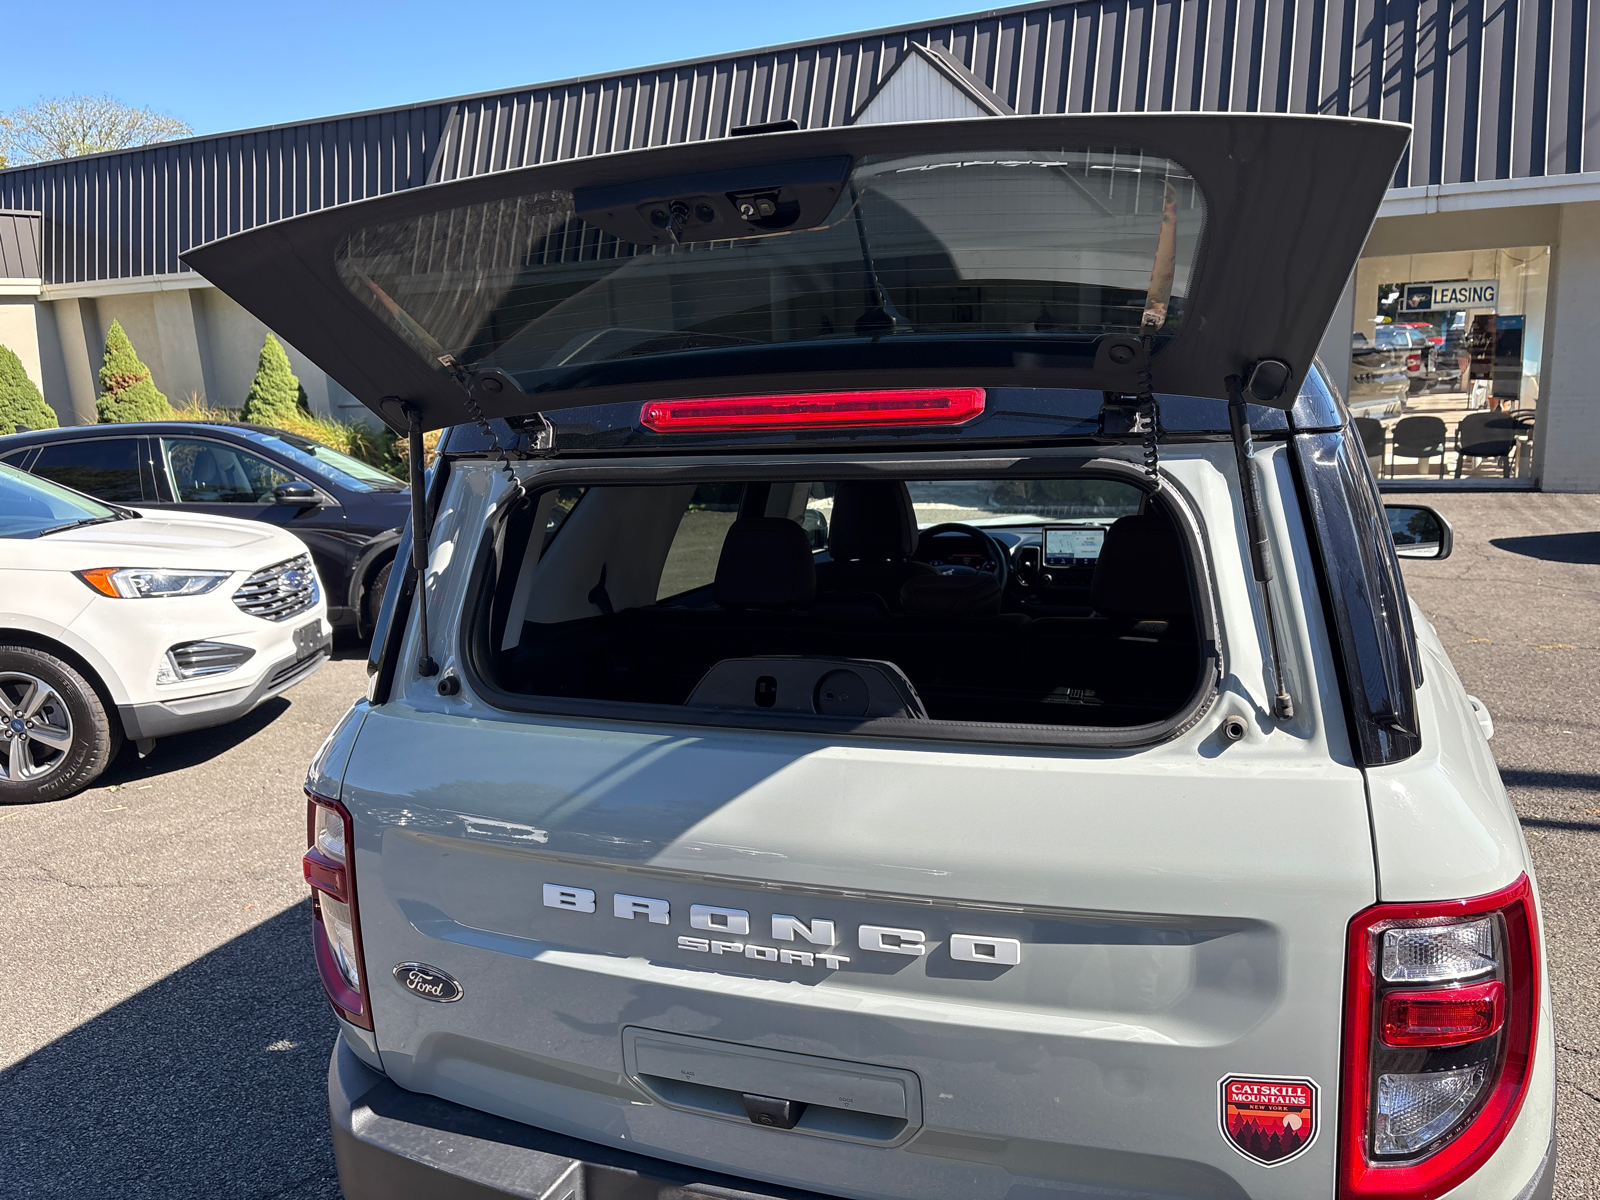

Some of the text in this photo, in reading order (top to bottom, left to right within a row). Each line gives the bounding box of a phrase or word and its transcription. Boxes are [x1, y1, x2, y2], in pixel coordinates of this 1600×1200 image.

[1434, 286, 1495, 304] LEASING
[542, 883, 1022, 965] BRONCO
[677, 936, 851, 970] SPORT
[406, 970, 444, 996] Ford
[1231, 1084, 1306, 1096] CATSKILL
[1231, 1094, 1306, 1104] MOUNTAINS
